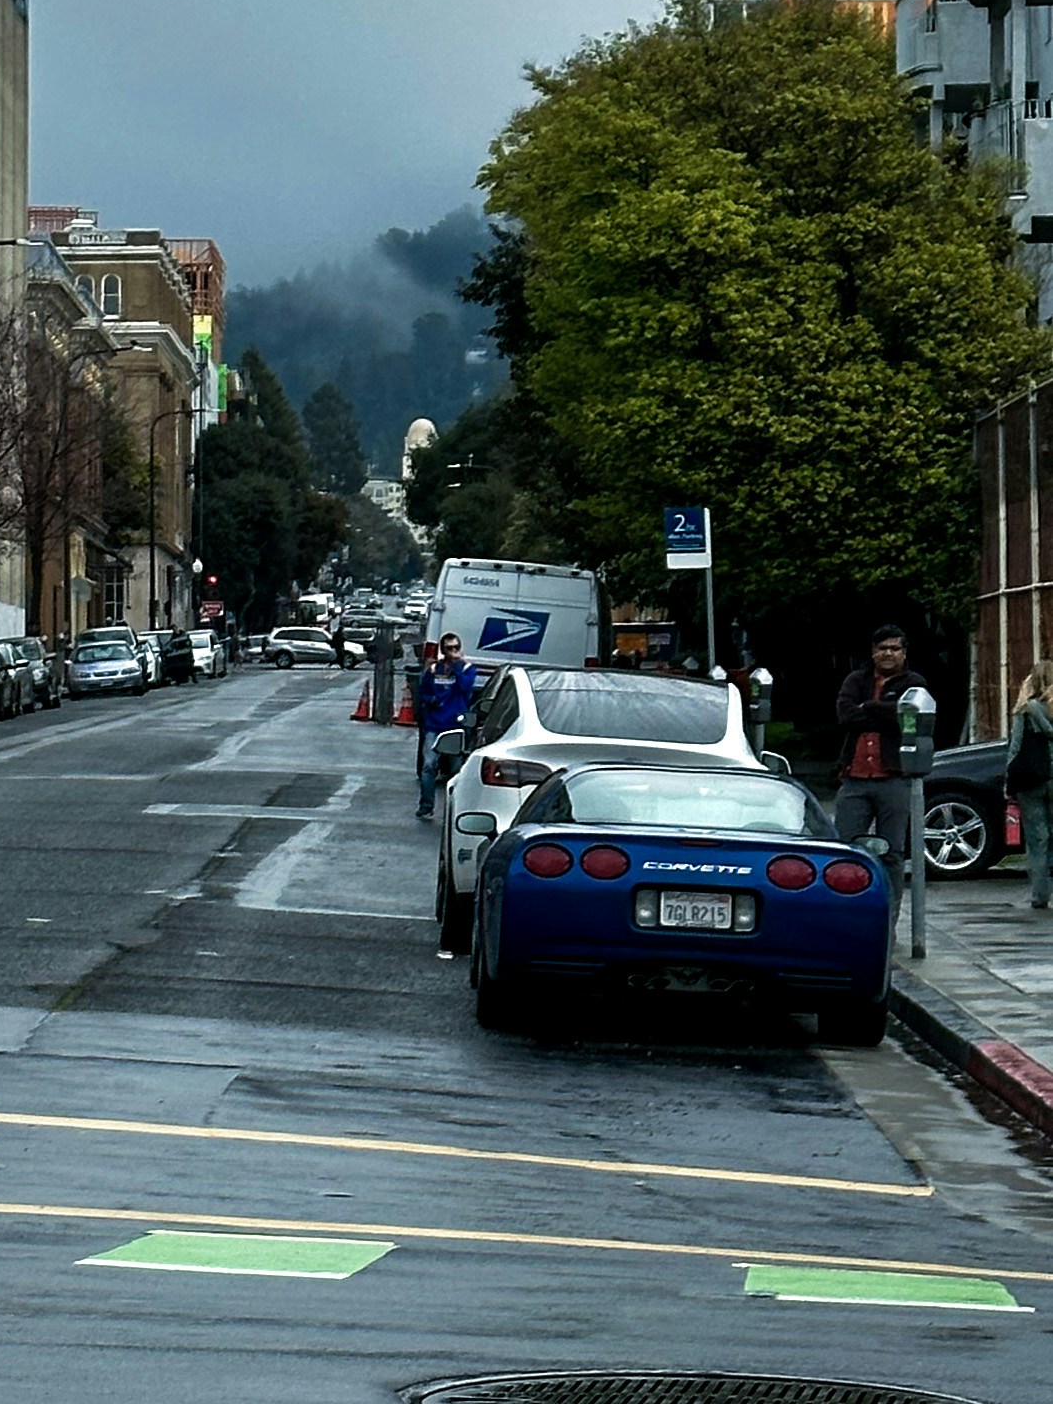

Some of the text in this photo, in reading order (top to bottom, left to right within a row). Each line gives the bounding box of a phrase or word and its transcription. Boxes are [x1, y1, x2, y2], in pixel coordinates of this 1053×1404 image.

[674, 514, 686, 532] 2
[643, 861, 753, 874] CORVETTE
[665, 904, 727, 924] 7GLR215
